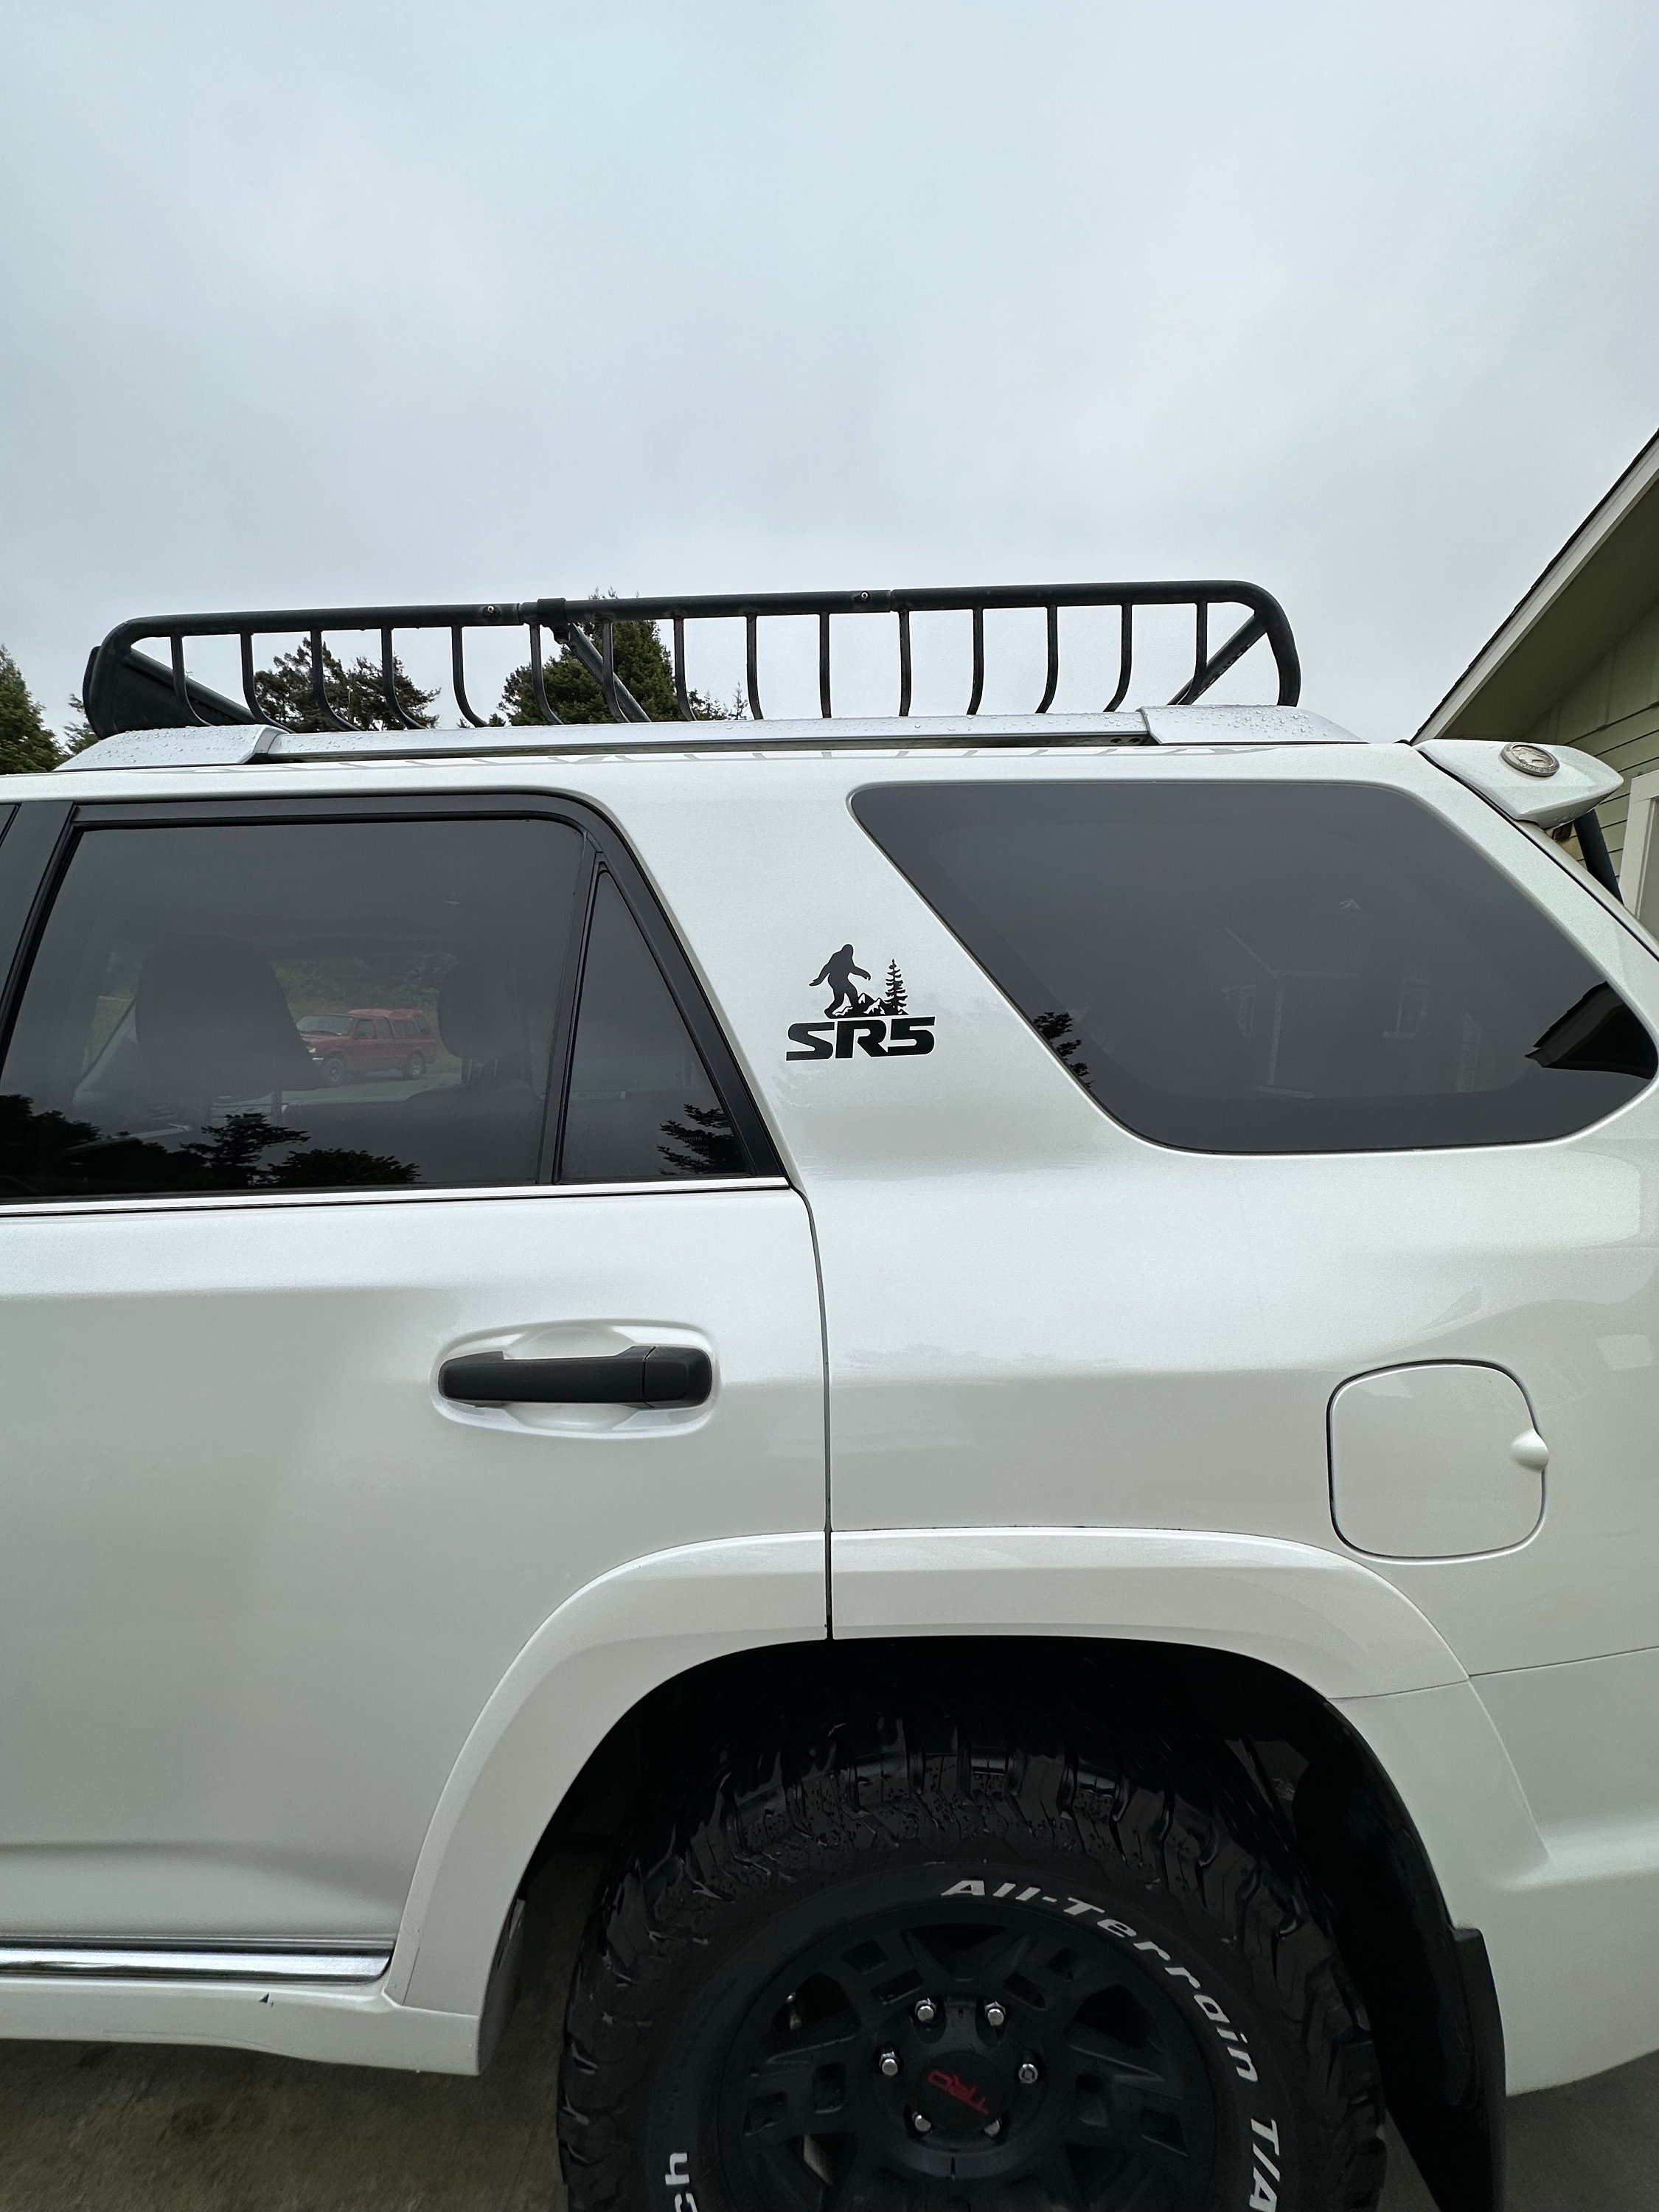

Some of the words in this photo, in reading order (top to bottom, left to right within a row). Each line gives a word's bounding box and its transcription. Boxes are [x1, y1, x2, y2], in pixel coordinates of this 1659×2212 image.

[786, 1016, 935, 1061] SR5
[941, 1880, 1258, 2082] All-Terrain
[1250, 2118, 1281, 2212] T/A
[927, 2069, 990, 2115] TRD
